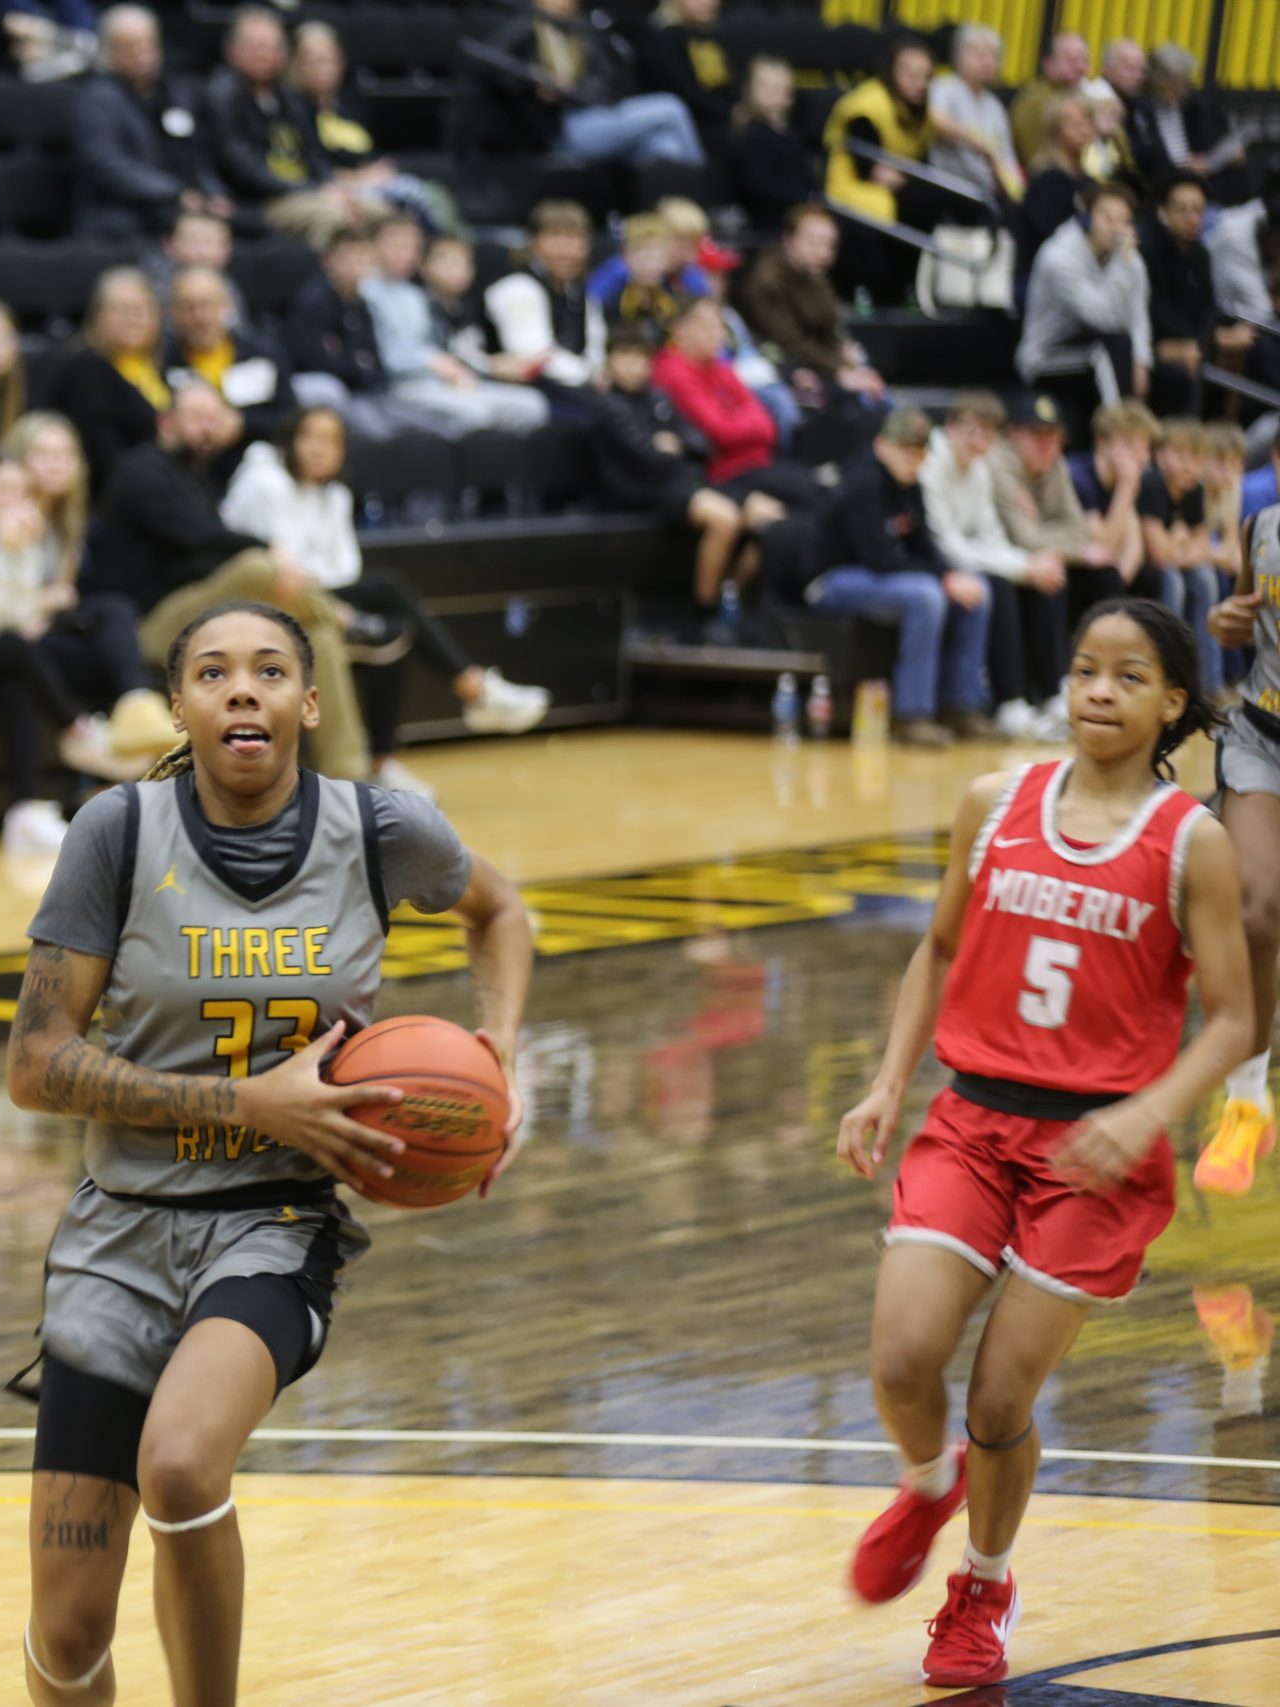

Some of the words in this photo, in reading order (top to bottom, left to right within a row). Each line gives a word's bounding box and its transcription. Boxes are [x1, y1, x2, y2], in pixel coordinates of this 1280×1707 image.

[983, 867, 1156, 942] MOBERLY
[180, 925, 333, 979] THREE
[1017, 935, 1081, 1030] 5
[200, 997, 320, 1079] 33
[175, 1122, 286, 1163] RIV
[42, 1519, 109, 1551] 2004
